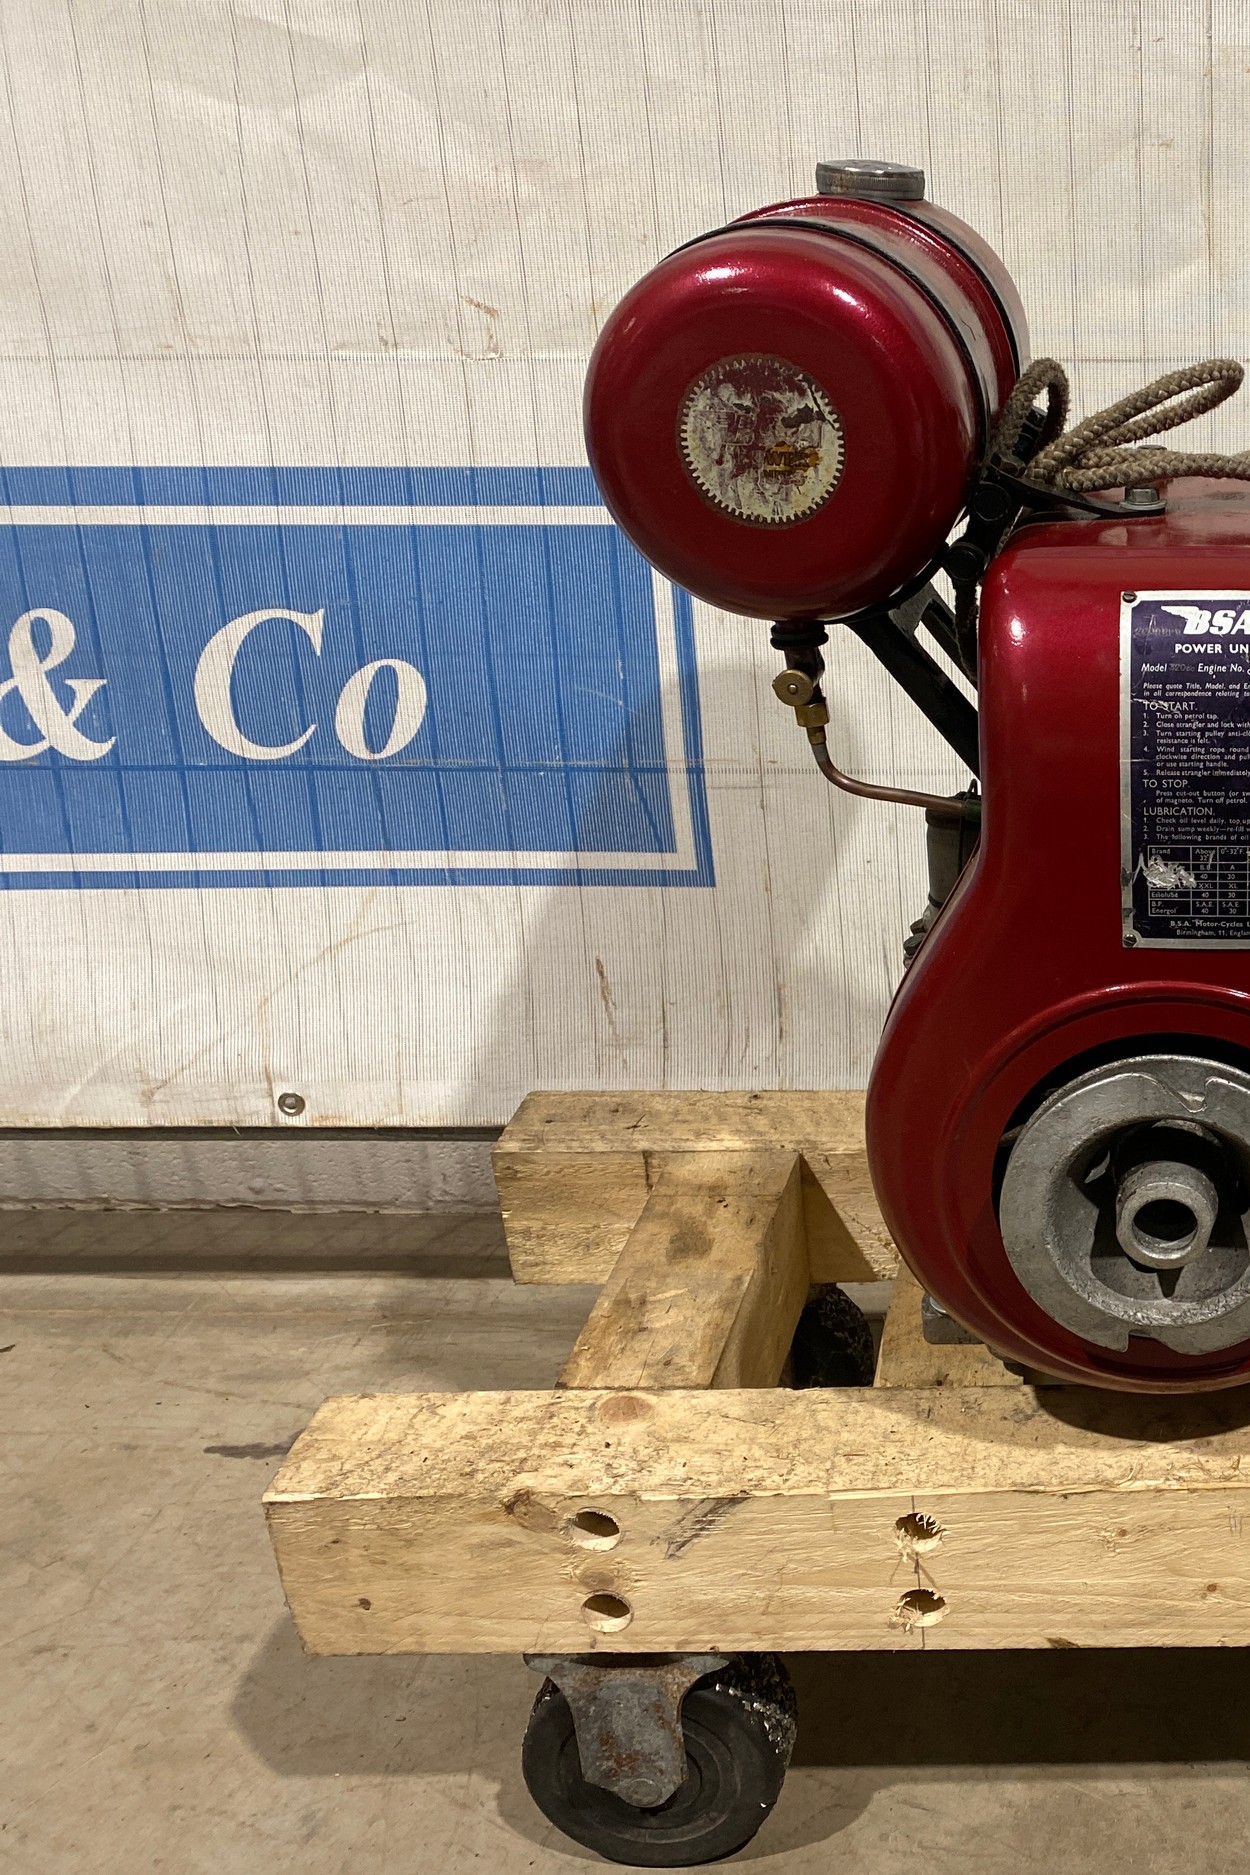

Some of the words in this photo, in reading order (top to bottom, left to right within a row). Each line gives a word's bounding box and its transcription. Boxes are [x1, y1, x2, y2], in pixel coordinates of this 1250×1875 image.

[1175, 643, 1222, 654] POWER
[1141, 663, 1167, 672] Model
[1198, 663, 1227, 674] Engine
[1230, 663, 1245, 673] No.
[0, 608, 116, 761] &
[194, 608, 427, 760] Co
[1143, 702, 1158, 710] TO
[1176, 730, 1201, 738] starting
[1180, 746, 1205, 754] starting
[1142, 780, 1158, 788] TO
[1162, 780, 1190, 788] STOP.
[1143, 806, 1216, 816] LUBRICATION.
